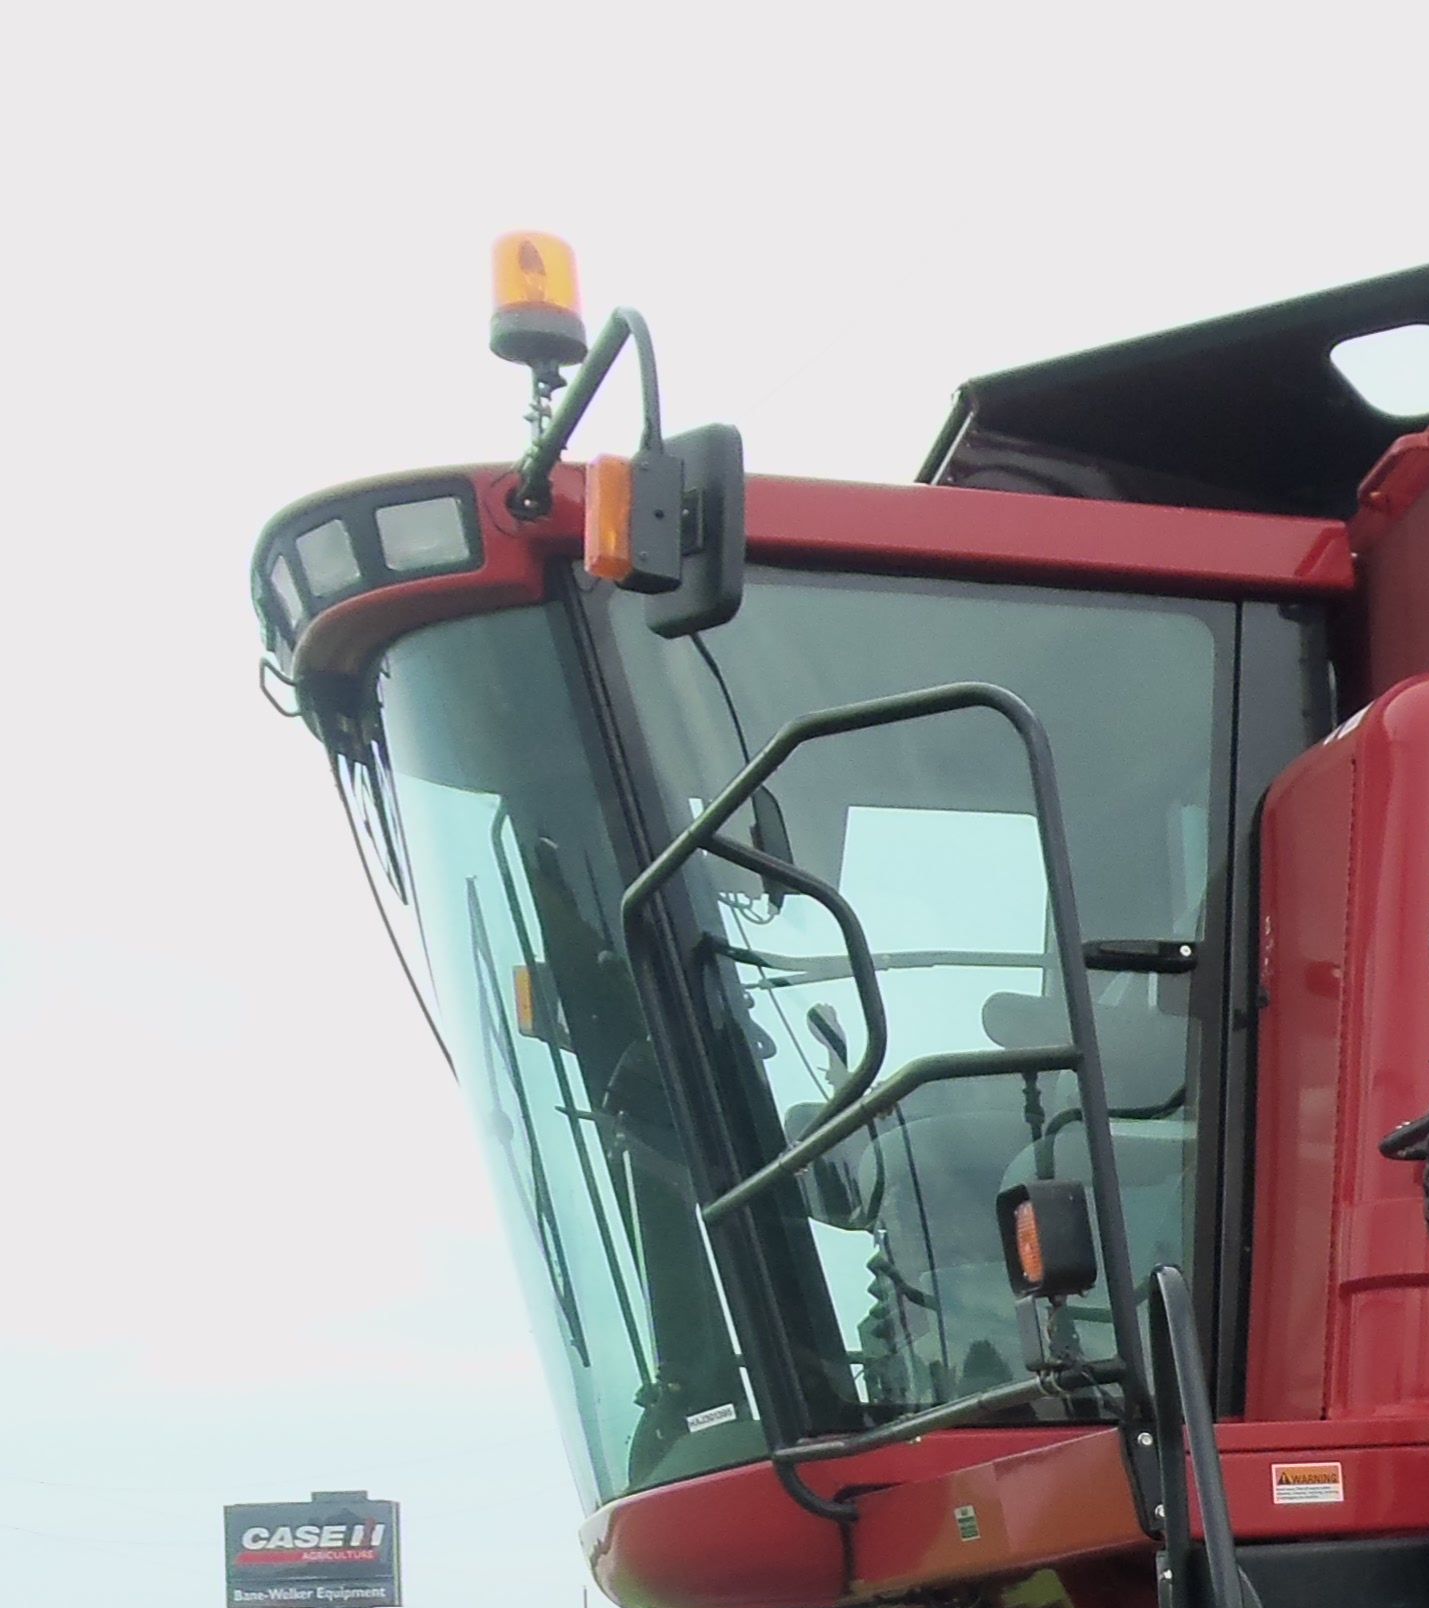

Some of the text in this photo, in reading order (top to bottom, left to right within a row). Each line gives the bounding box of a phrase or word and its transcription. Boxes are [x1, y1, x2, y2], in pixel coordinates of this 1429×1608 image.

[1291, 1473, 1338, 1483] WARNING
[242, 1525, 346, 1550] CASE
[302, 1550, 374, 1560] AGRICULTURE
[316, 1586, 386, 1601] Equipment
